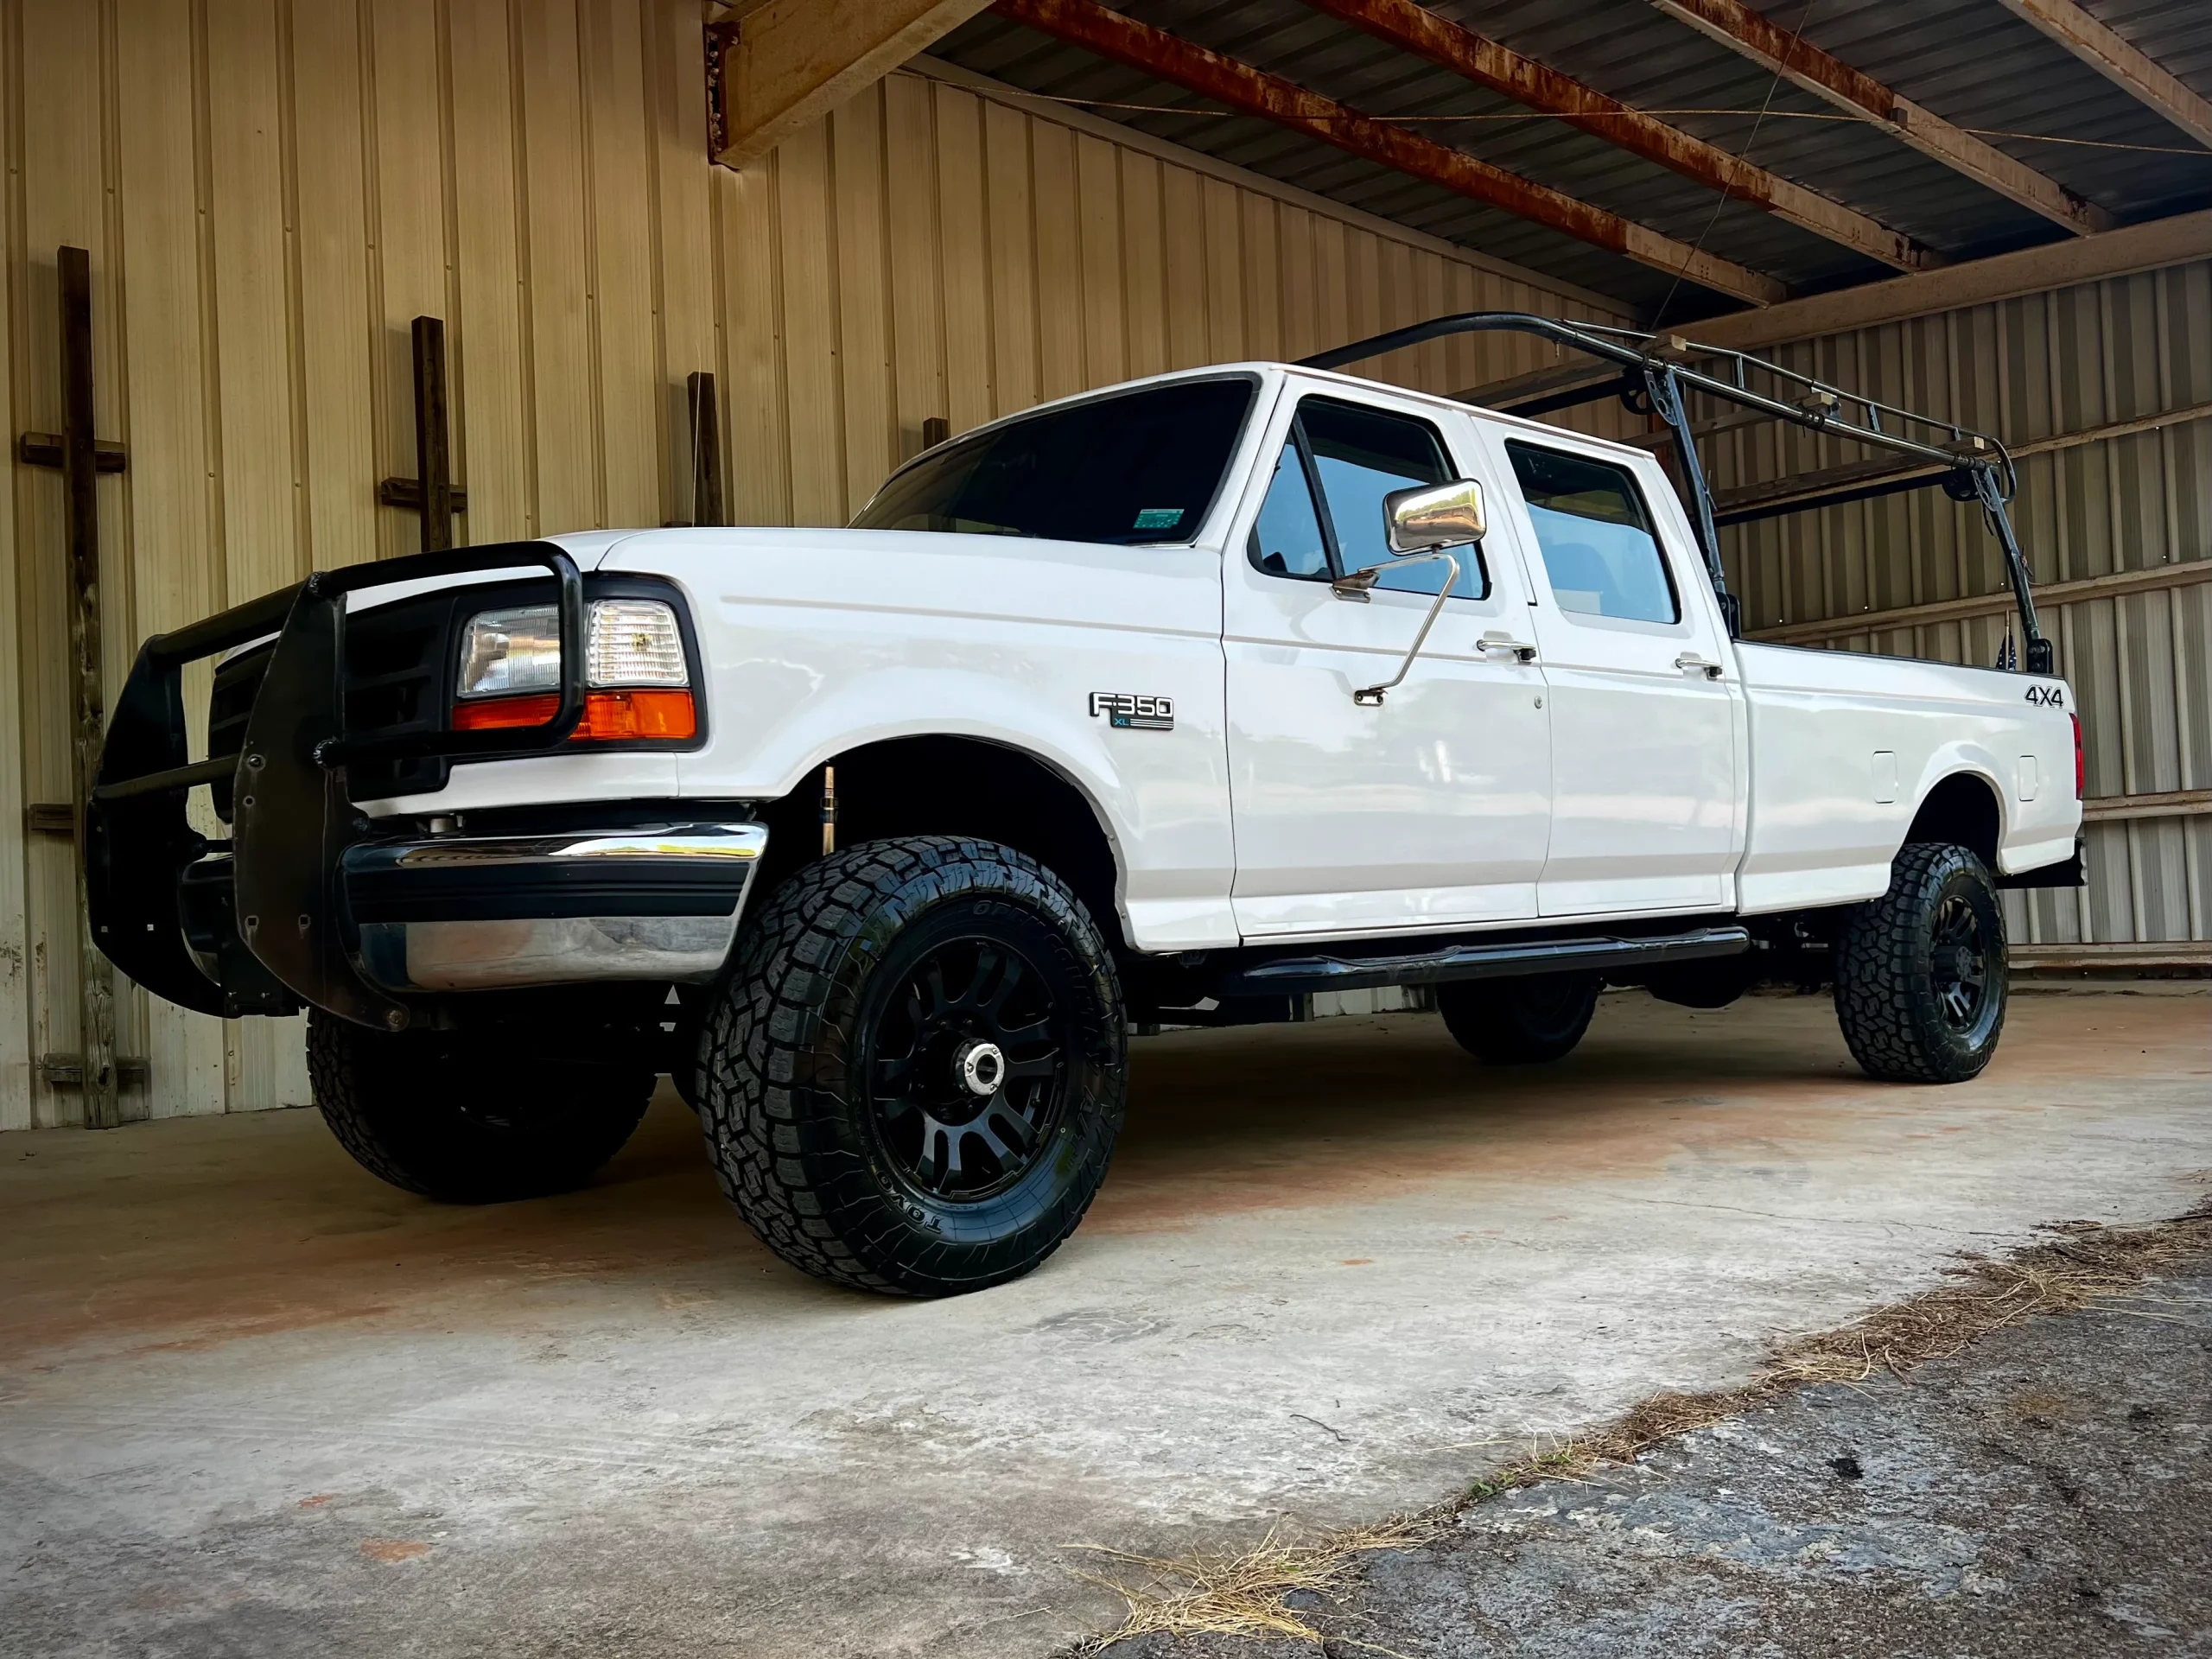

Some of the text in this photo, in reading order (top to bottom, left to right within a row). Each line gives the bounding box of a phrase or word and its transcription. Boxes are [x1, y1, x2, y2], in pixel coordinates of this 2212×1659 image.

[2024, 685, 2064, 708] 4X4
[1114, 717, 1129, 726] XL
[874, 1170, 942, 1234] TOYO
